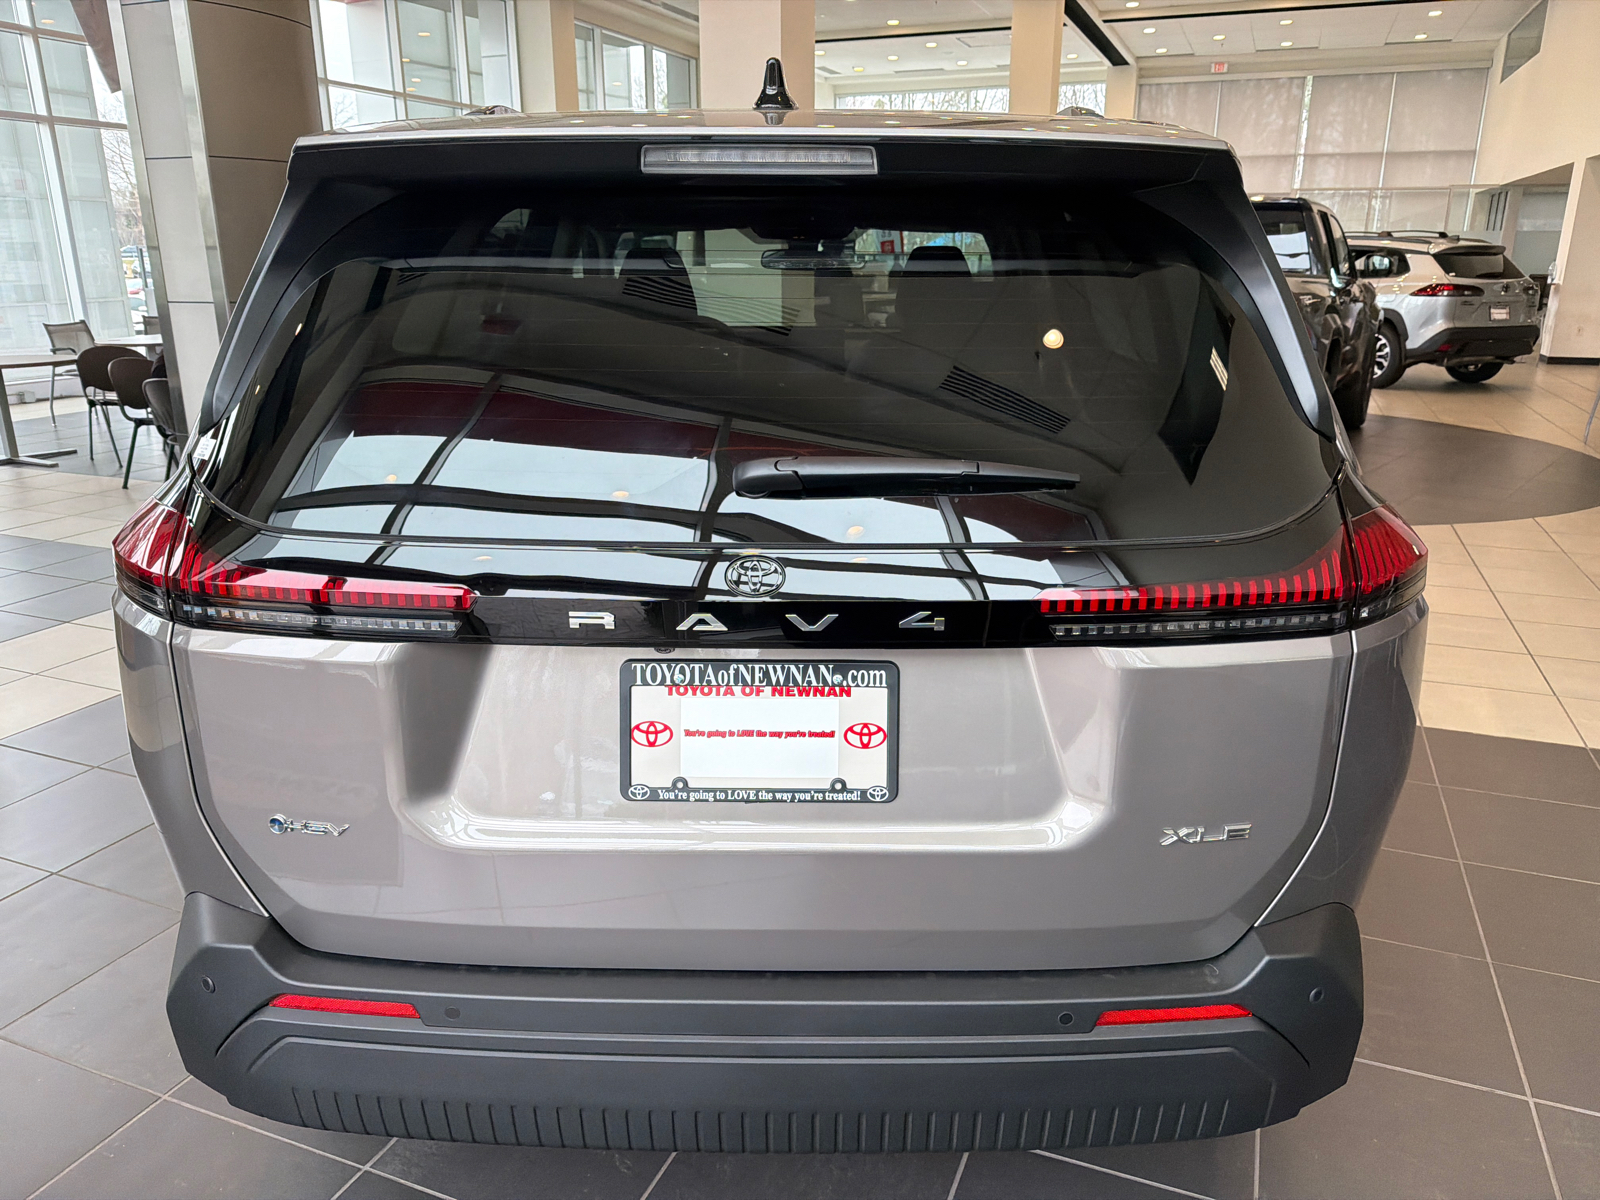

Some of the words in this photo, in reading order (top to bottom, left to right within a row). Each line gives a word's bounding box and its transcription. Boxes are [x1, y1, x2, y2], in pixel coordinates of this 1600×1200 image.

[568, 611, 945, 632] RAV4
[666, 686, 736, 698] TOYOTA
[740, 685, 766, 697] OF
[770, 686, 852, 698] NEWNAN
[706, 730, 727, 738] going
[768, 731, 784, 739] way
[657, 789, 688, 801] You're
[689, 791, 715, 802] going
[715, 790, 726, 800] to
[727, 790, 757, 800] LOVE
[758, 790, 774, 801] the
[774, 792, 793, 803] way
[794, 790, 824, 803] you're
[825, 790, 861, 801] treated!
[1159, 822, 1253, 846] XLE
